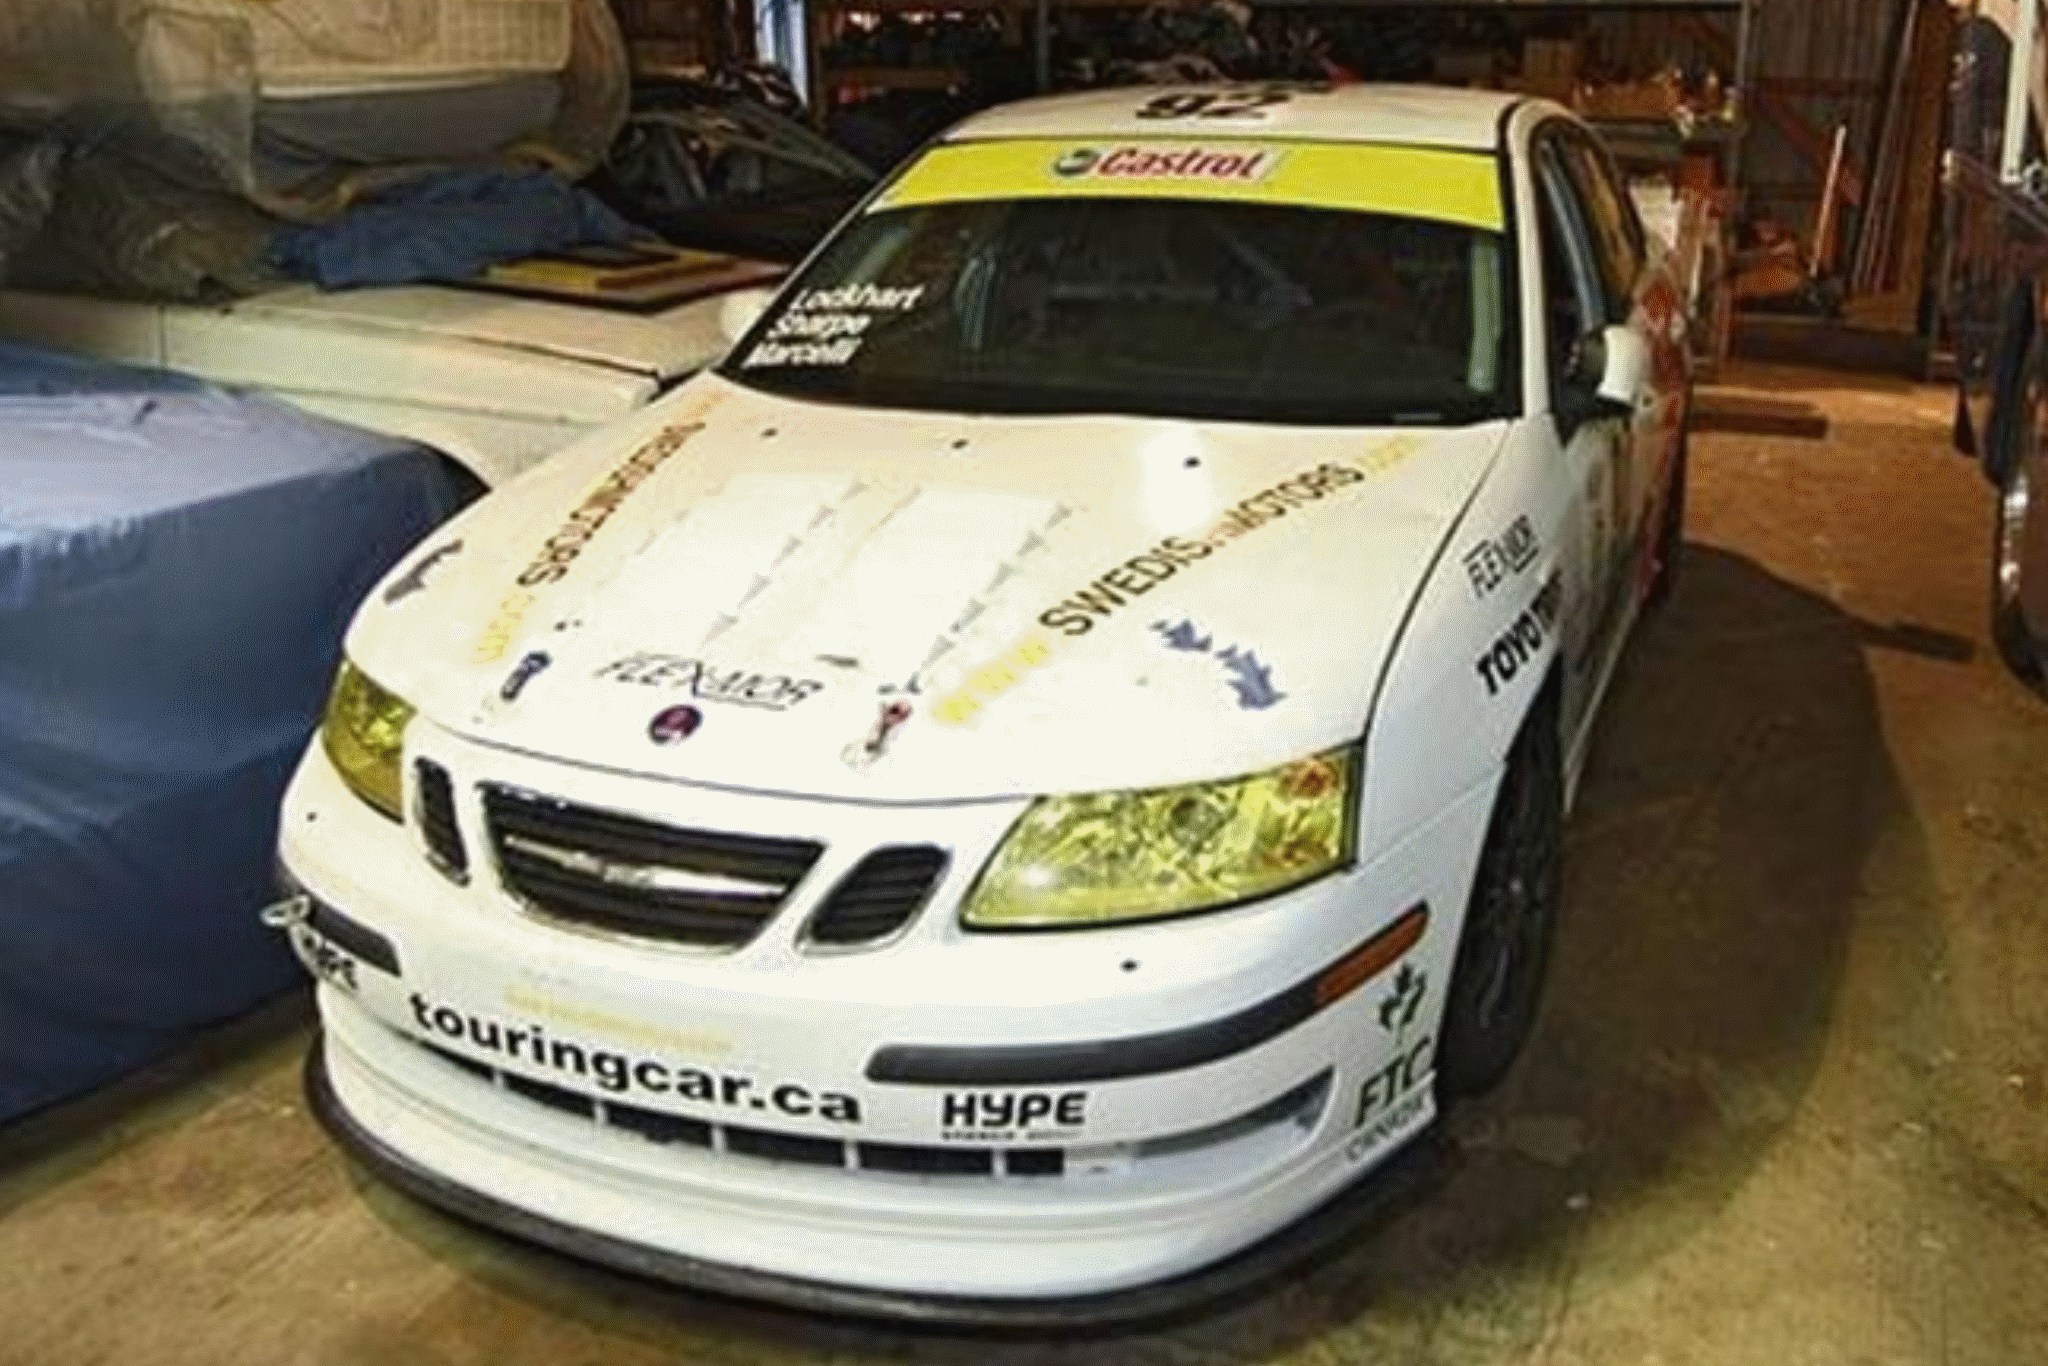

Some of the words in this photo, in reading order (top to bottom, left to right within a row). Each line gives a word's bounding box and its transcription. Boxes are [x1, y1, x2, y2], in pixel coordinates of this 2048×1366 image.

[1096, 145, 1266, 180] Castrol
[787, 282, 926, 312] Lockhart
[1476, 609, 1543, 697] TOYO
[409, 992, 863, 1124] touringcar.ca
[1355, 1034, 1432, 1130] FTC
[942, 1090, 1089, 1128] HYPE
